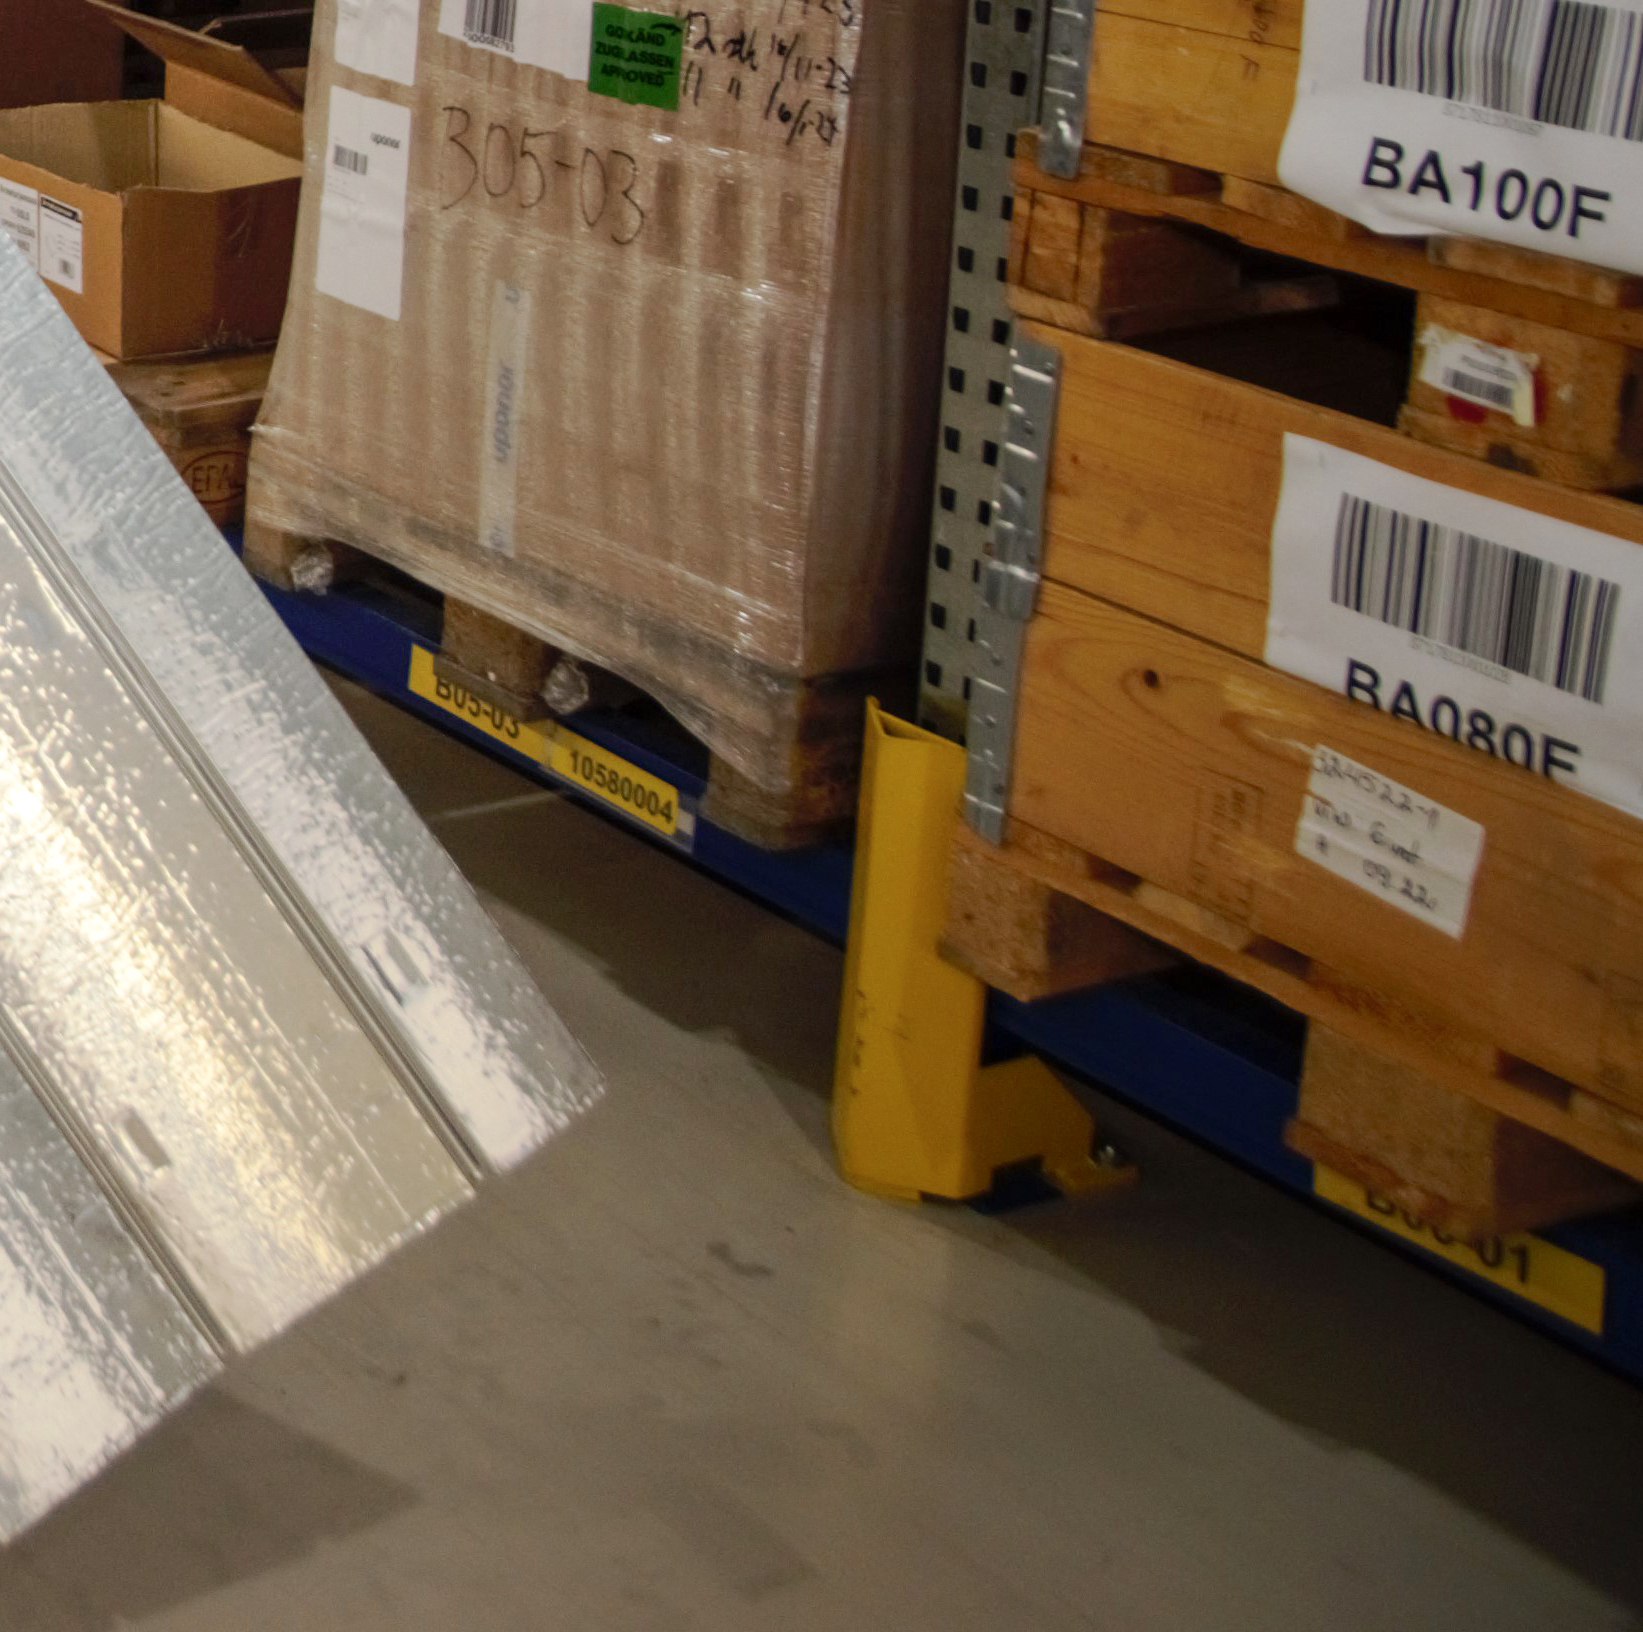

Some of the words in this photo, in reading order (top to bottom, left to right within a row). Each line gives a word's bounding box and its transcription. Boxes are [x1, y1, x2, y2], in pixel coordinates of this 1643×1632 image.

[604, 24, 666, 47] GOKÄND
[601, 63, 665, 87] APPOVED
[1361, 136, 1611, 238] BA100F
[1345, 656, 1581, 779] BA080F
[568, 748, 673, 824] 10580004
